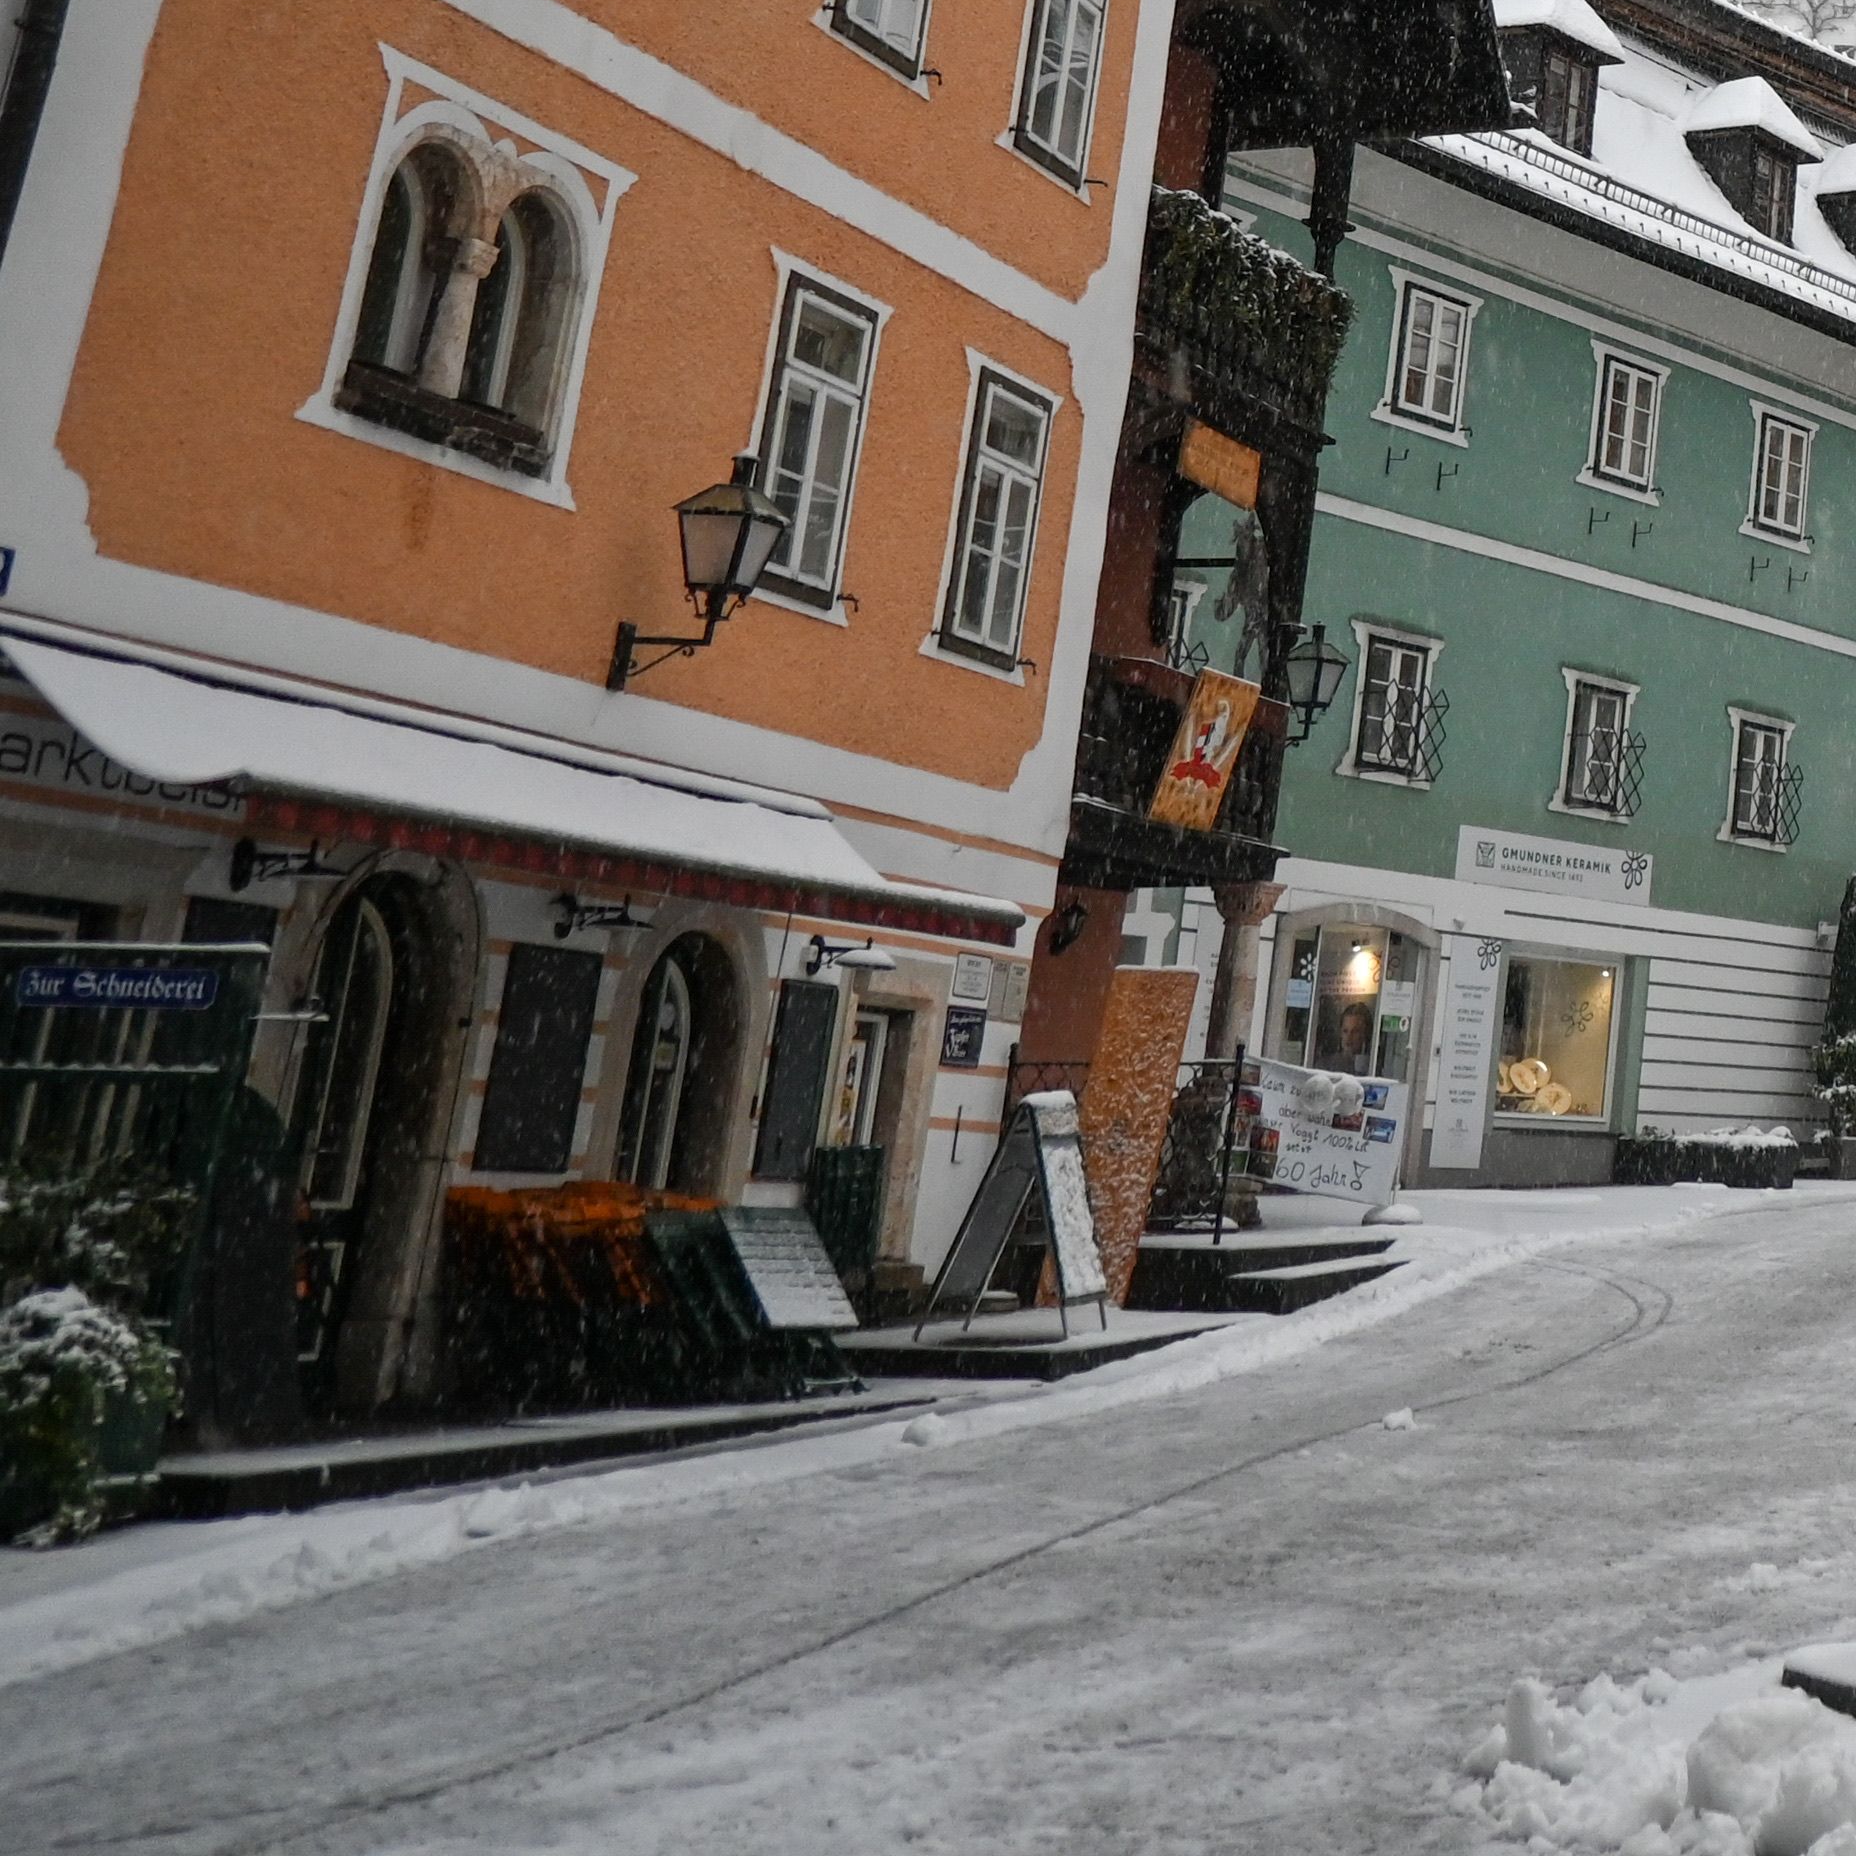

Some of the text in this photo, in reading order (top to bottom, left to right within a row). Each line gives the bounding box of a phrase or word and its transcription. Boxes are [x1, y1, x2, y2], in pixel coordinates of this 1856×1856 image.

[1500, 863, 1543, 878] HANDMADE
[1501, 847, 1612, 875] GMUNDNER KERAMIK
[72, 970, 207, 1001] Schneiderei
[1275, 1157, 1306, 1182] 60
